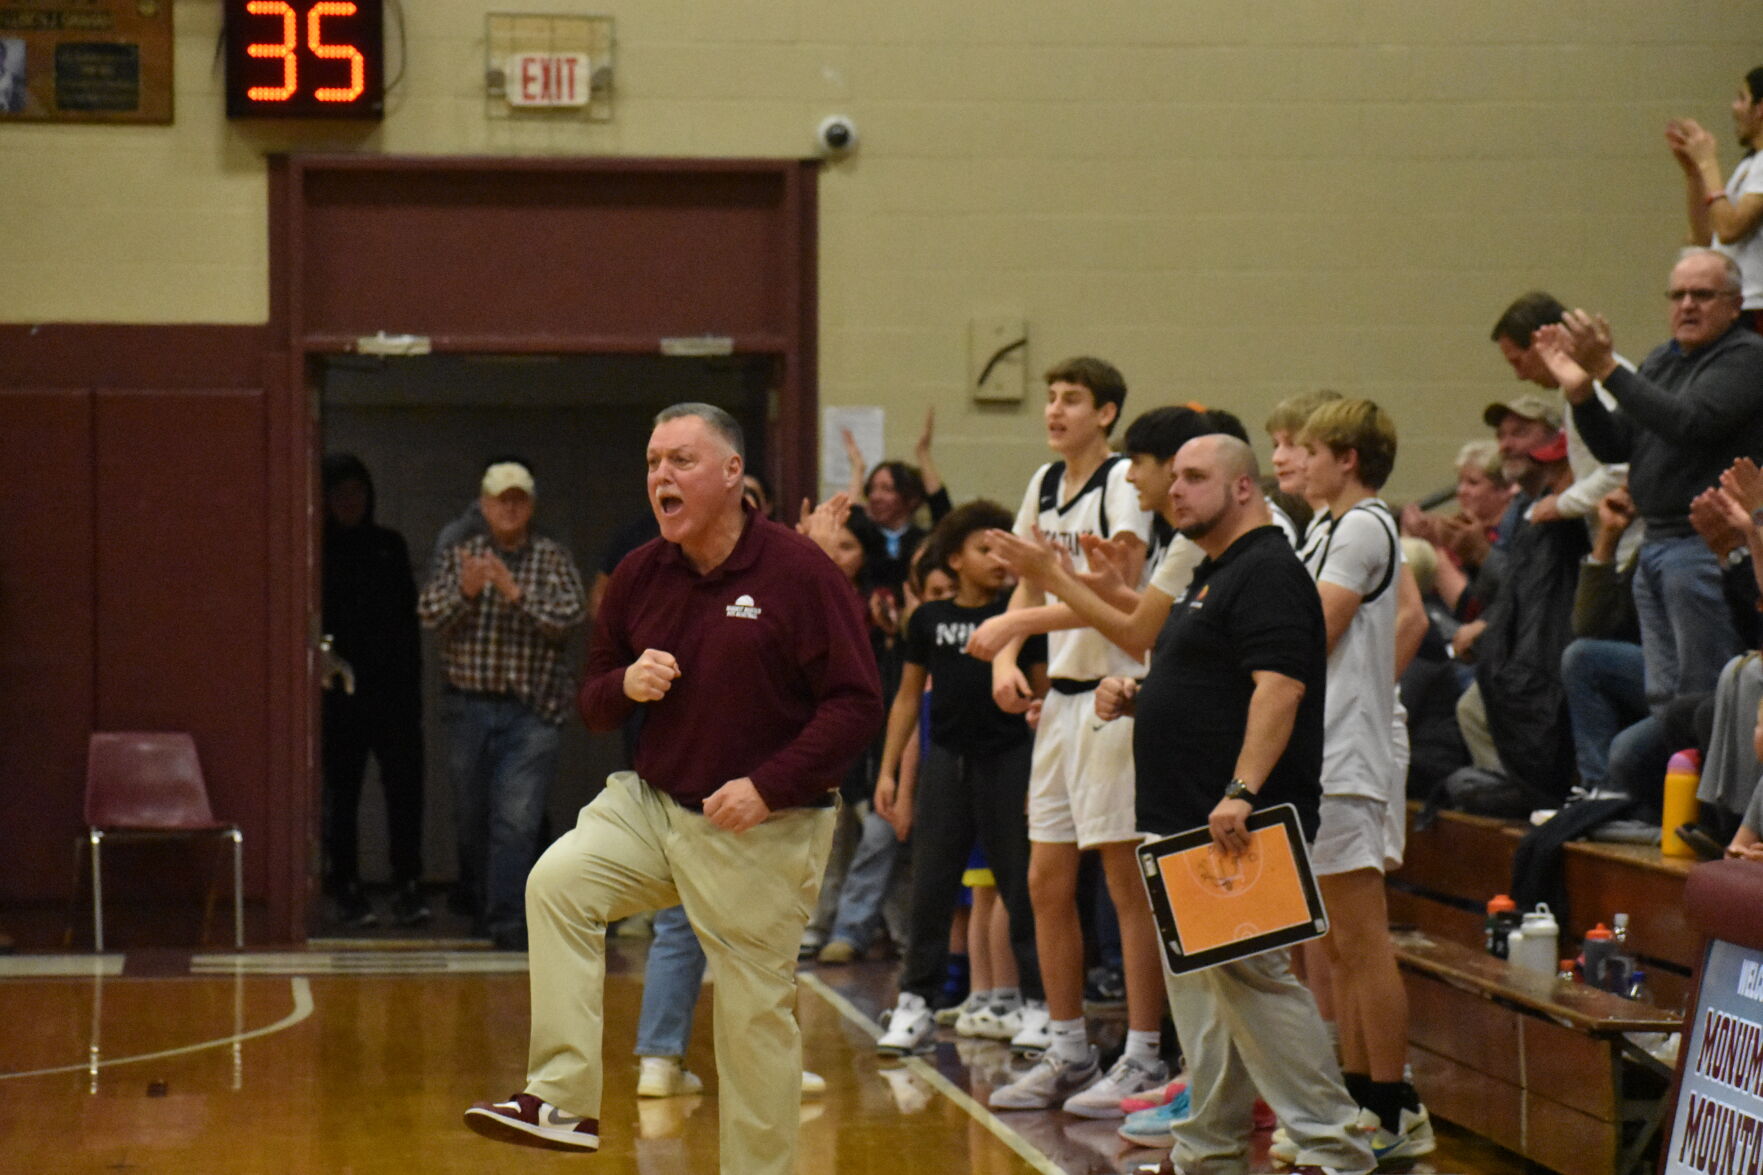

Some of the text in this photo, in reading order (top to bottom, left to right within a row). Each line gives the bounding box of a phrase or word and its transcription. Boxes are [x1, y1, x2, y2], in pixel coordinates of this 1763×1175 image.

[247, 1, 364, 101] 35
[521, 57, 578, 101] EXIT
[1695, 1006, 1763, 1099] MONUM
[1678, 1090, 1763, 1175] MOUNTA
